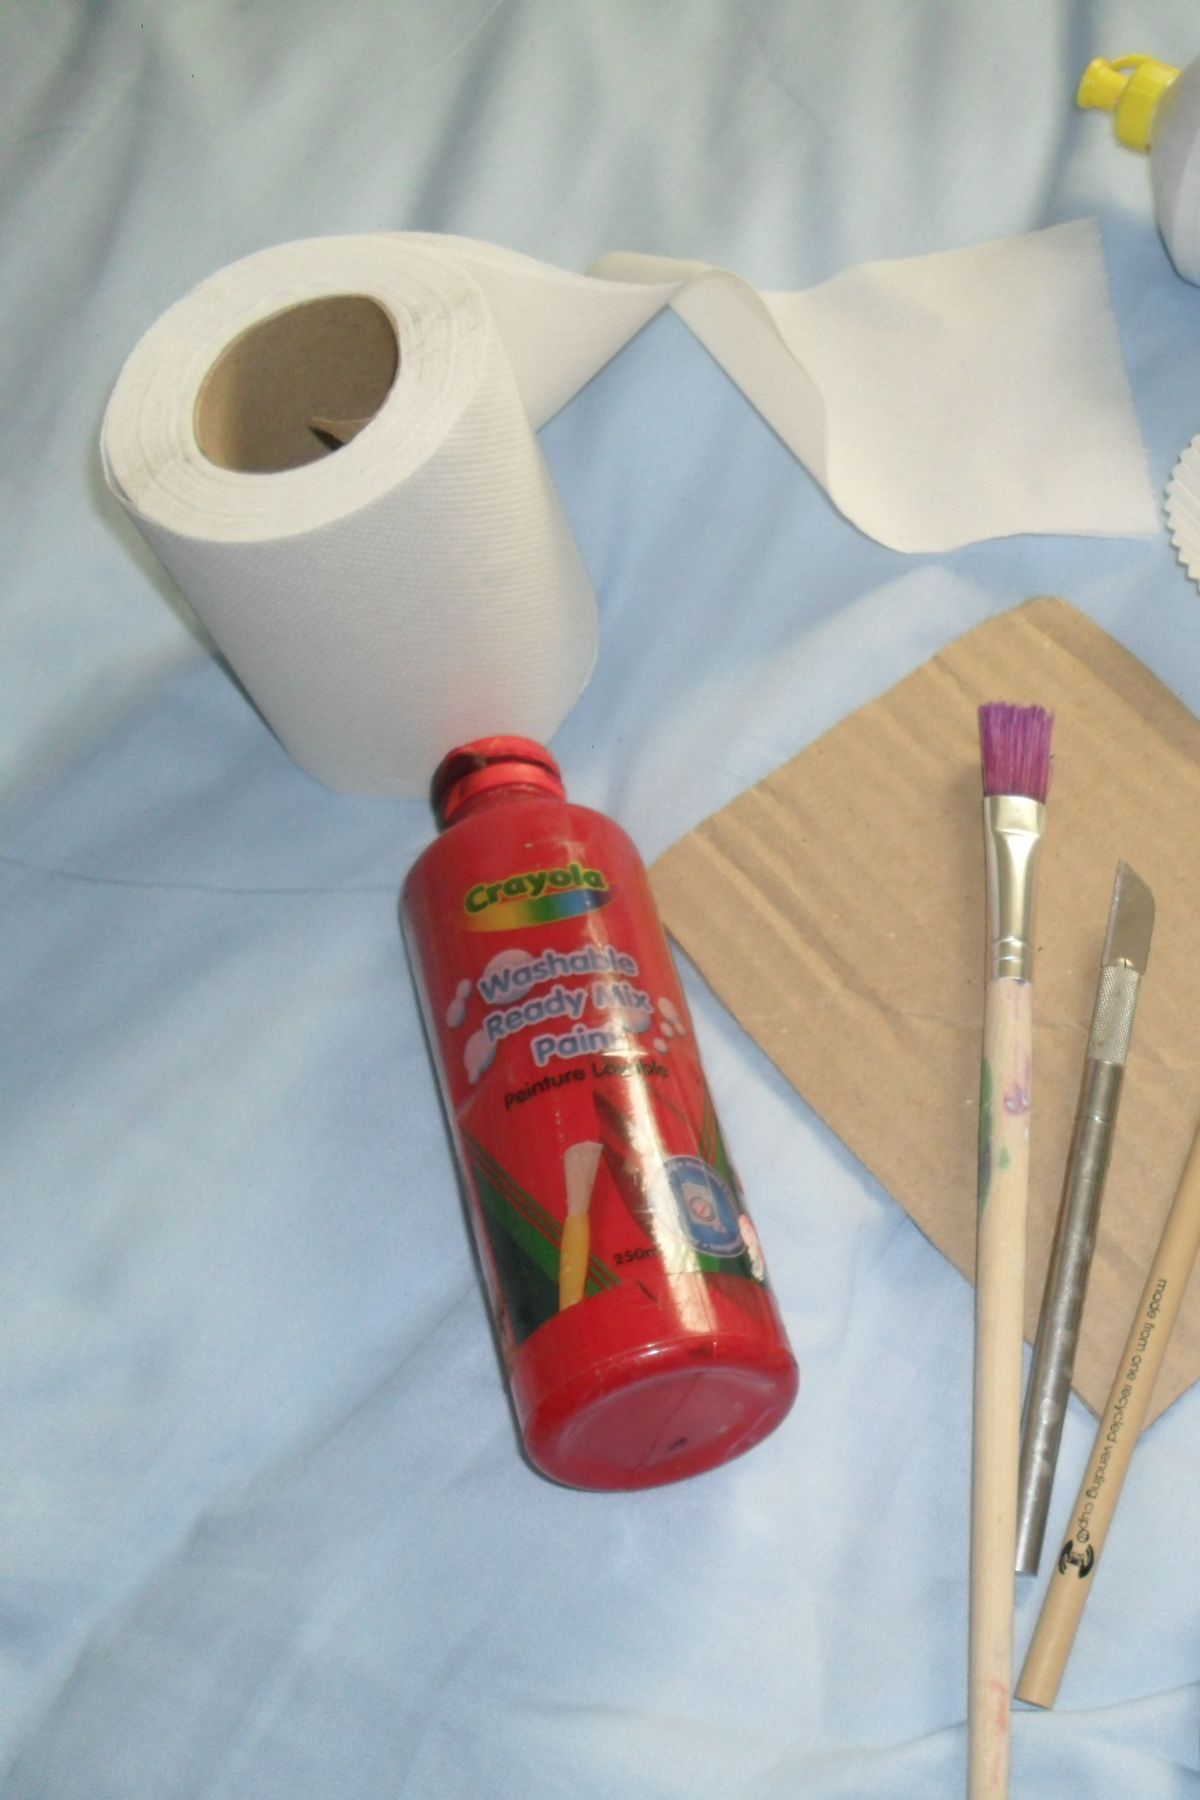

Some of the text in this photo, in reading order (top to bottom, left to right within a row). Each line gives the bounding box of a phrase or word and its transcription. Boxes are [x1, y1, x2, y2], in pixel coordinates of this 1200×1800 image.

[464, 862, 609, 915] Crayola
[478, 945, 638, 1004] Washable
[484, 981, 653, 1041] Ready Mix
[531, 1022, 620, 1068] Pain
[504, 1060, 668, 1110] Peinture Lavble
[1146, 1278, 1168, 1319] made
[1135, 1321, 1155, 1353] from
[1125, 1354, 1142, 1381] one
[1104, 1383, 1133, 1443] recycled
[1085, 1444, 1114, 1500] vending
